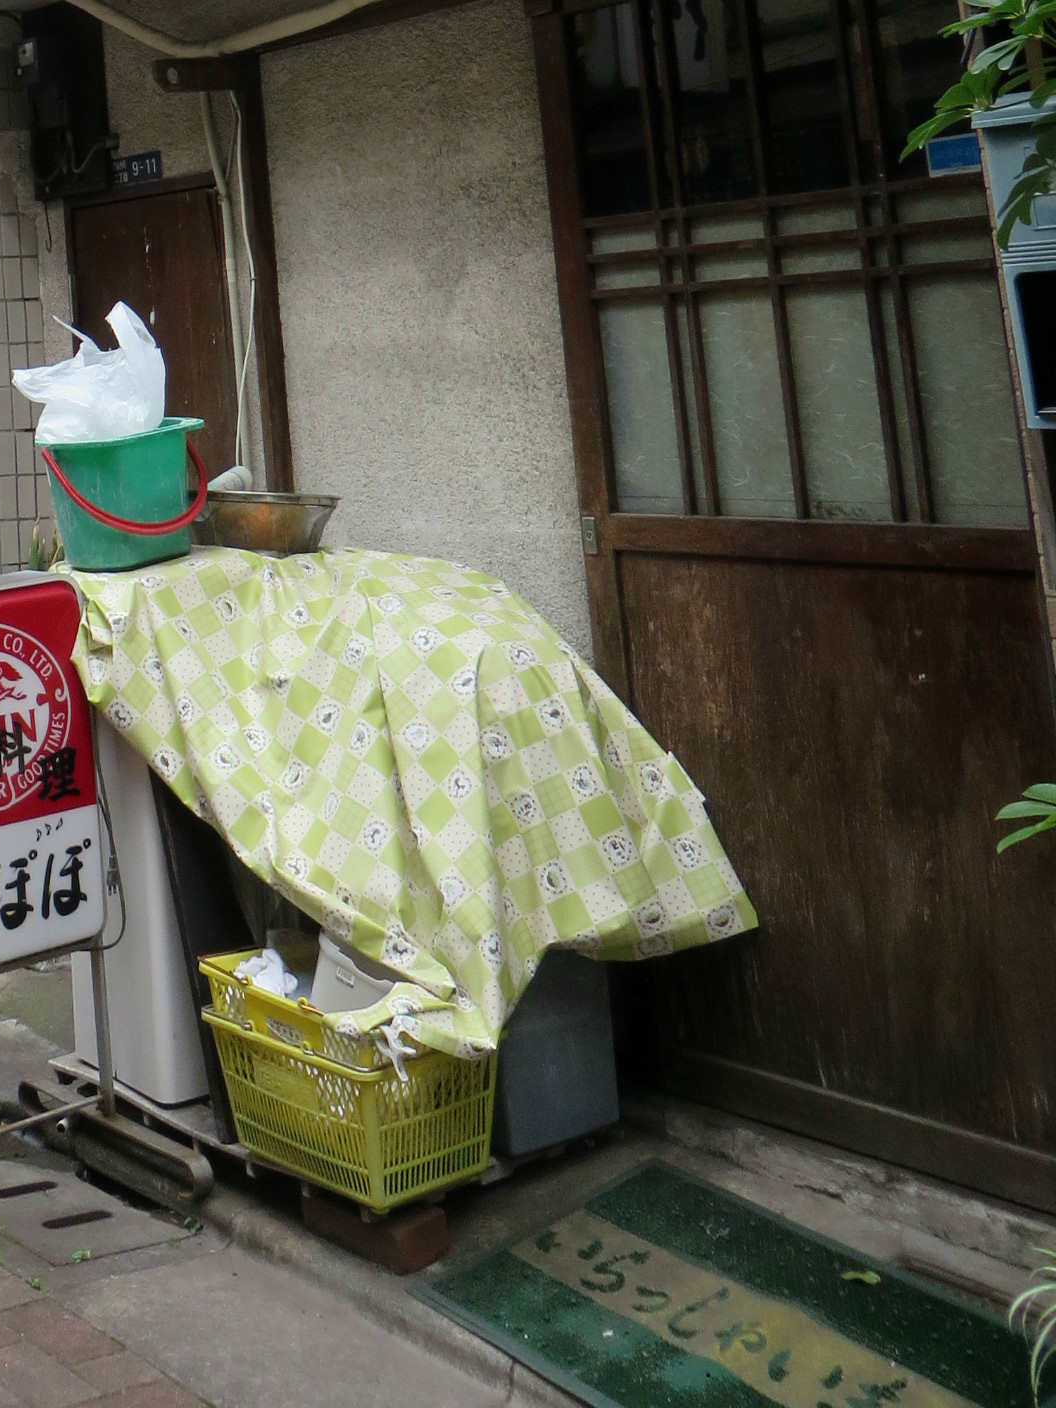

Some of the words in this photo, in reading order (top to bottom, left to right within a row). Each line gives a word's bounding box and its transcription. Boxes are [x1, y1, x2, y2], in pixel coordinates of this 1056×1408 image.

[131, 157, 157, 176] 9-11
[29, 652, 54, 681] LTD.
[43, 712, 66, 755] TIMES
